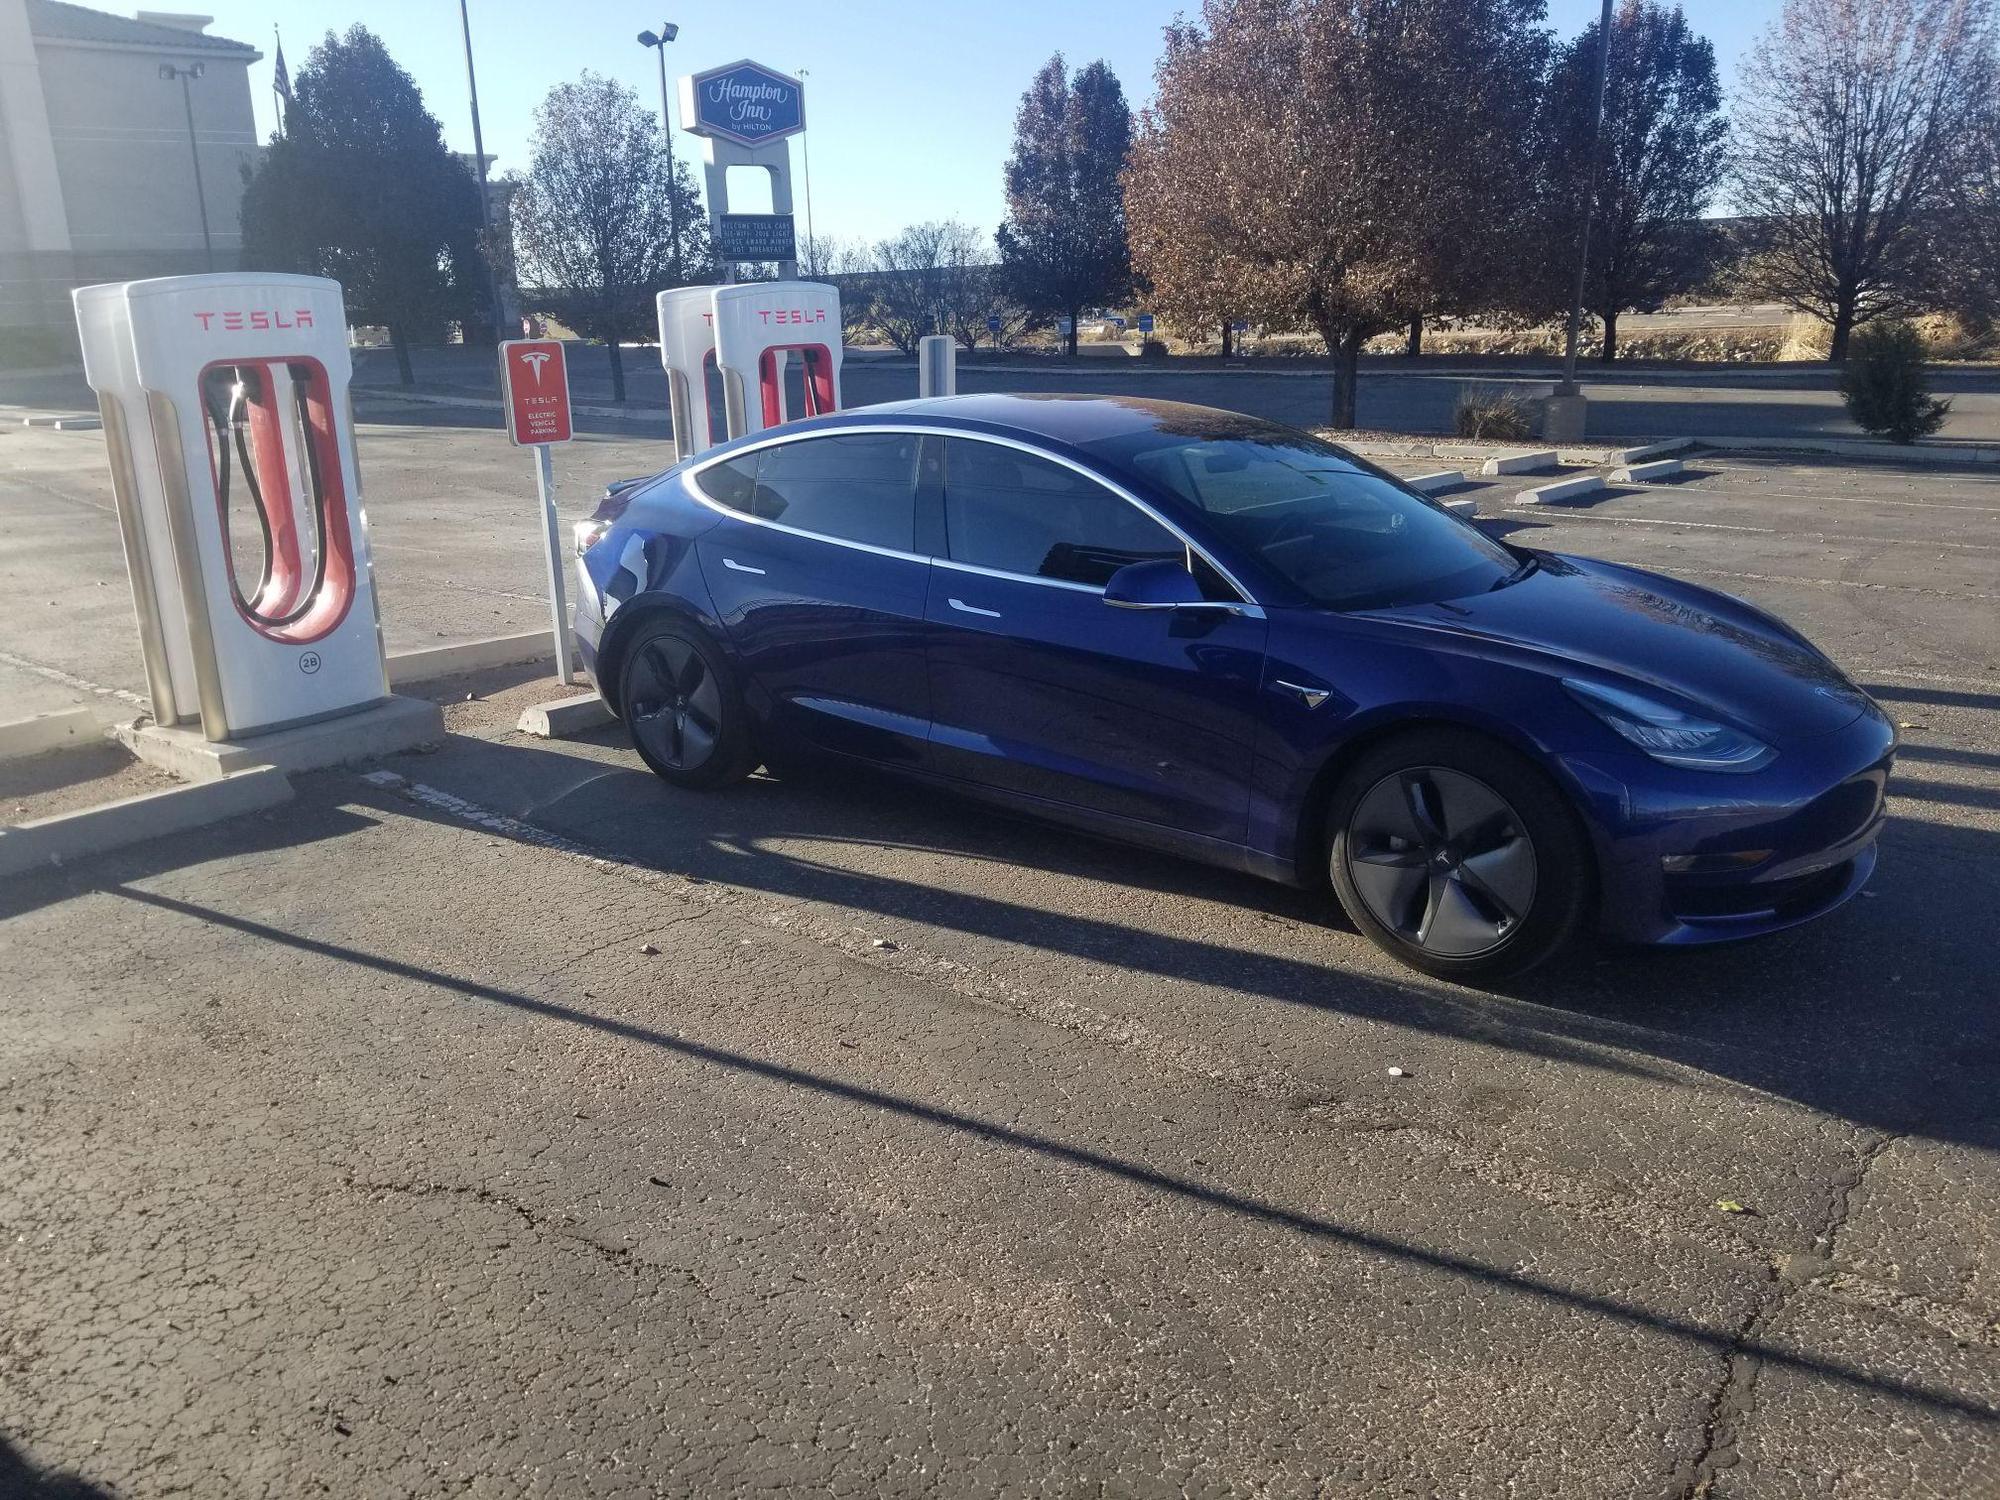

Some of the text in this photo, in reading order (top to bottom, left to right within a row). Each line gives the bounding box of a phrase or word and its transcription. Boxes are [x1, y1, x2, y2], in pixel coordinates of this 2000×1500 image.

[709, 79, 788, 103] Hampton
[730, 100, 771, 120] Inn
[731, 122, 772, 131] by HILTON
[721, 222, 750, 230] WELCOME
[752, 222, 772, 230] TESLA
[193, 310, 313, 331] TESLA
[758, 309, 826, 325] TESLA
[524, 396, 557, 405] TESLA
[302, 657, 318, 668] 2B
